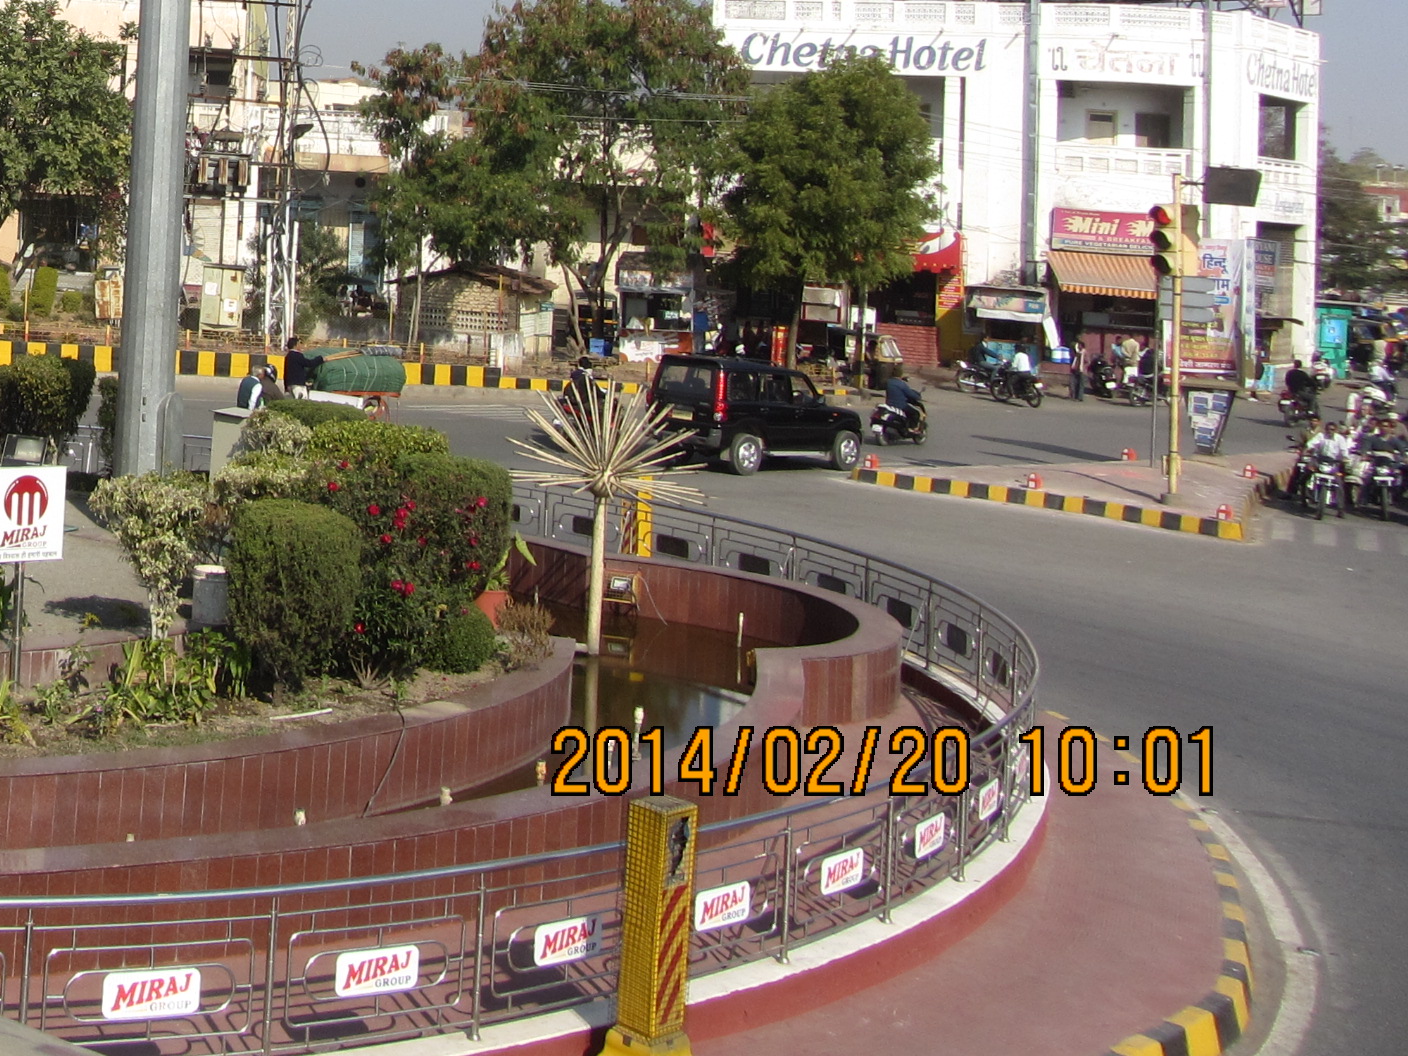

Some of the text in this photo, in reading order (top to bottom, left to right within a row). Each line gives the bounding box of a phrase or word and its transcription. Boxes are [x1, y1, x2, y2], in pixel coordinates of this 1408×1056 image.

[892, 36, 987, 71] Hotel
[1074, 40, 1180, 75] चेतना
[1247, 52, 1290, 93] Chetna
[1062, 215, 1120, 236] Mini
[0, 525, 47, 548] MIRAJ
[825, 851, 860, 889] MIRAJ
[700, 885, 746, 924] MIRAJ
[722, 908, 746, 921] GROUP
[540, 918, 597, 959] MIRAJ
[567, 942, 597, 956] GROUP
[343, 950, 412, 991] MIRAJ
[375, 975, 411, 988] GROUP
[111, 973, 192, 1012] MIRAJ
[149, 1000, 191, 1011] GROUP
